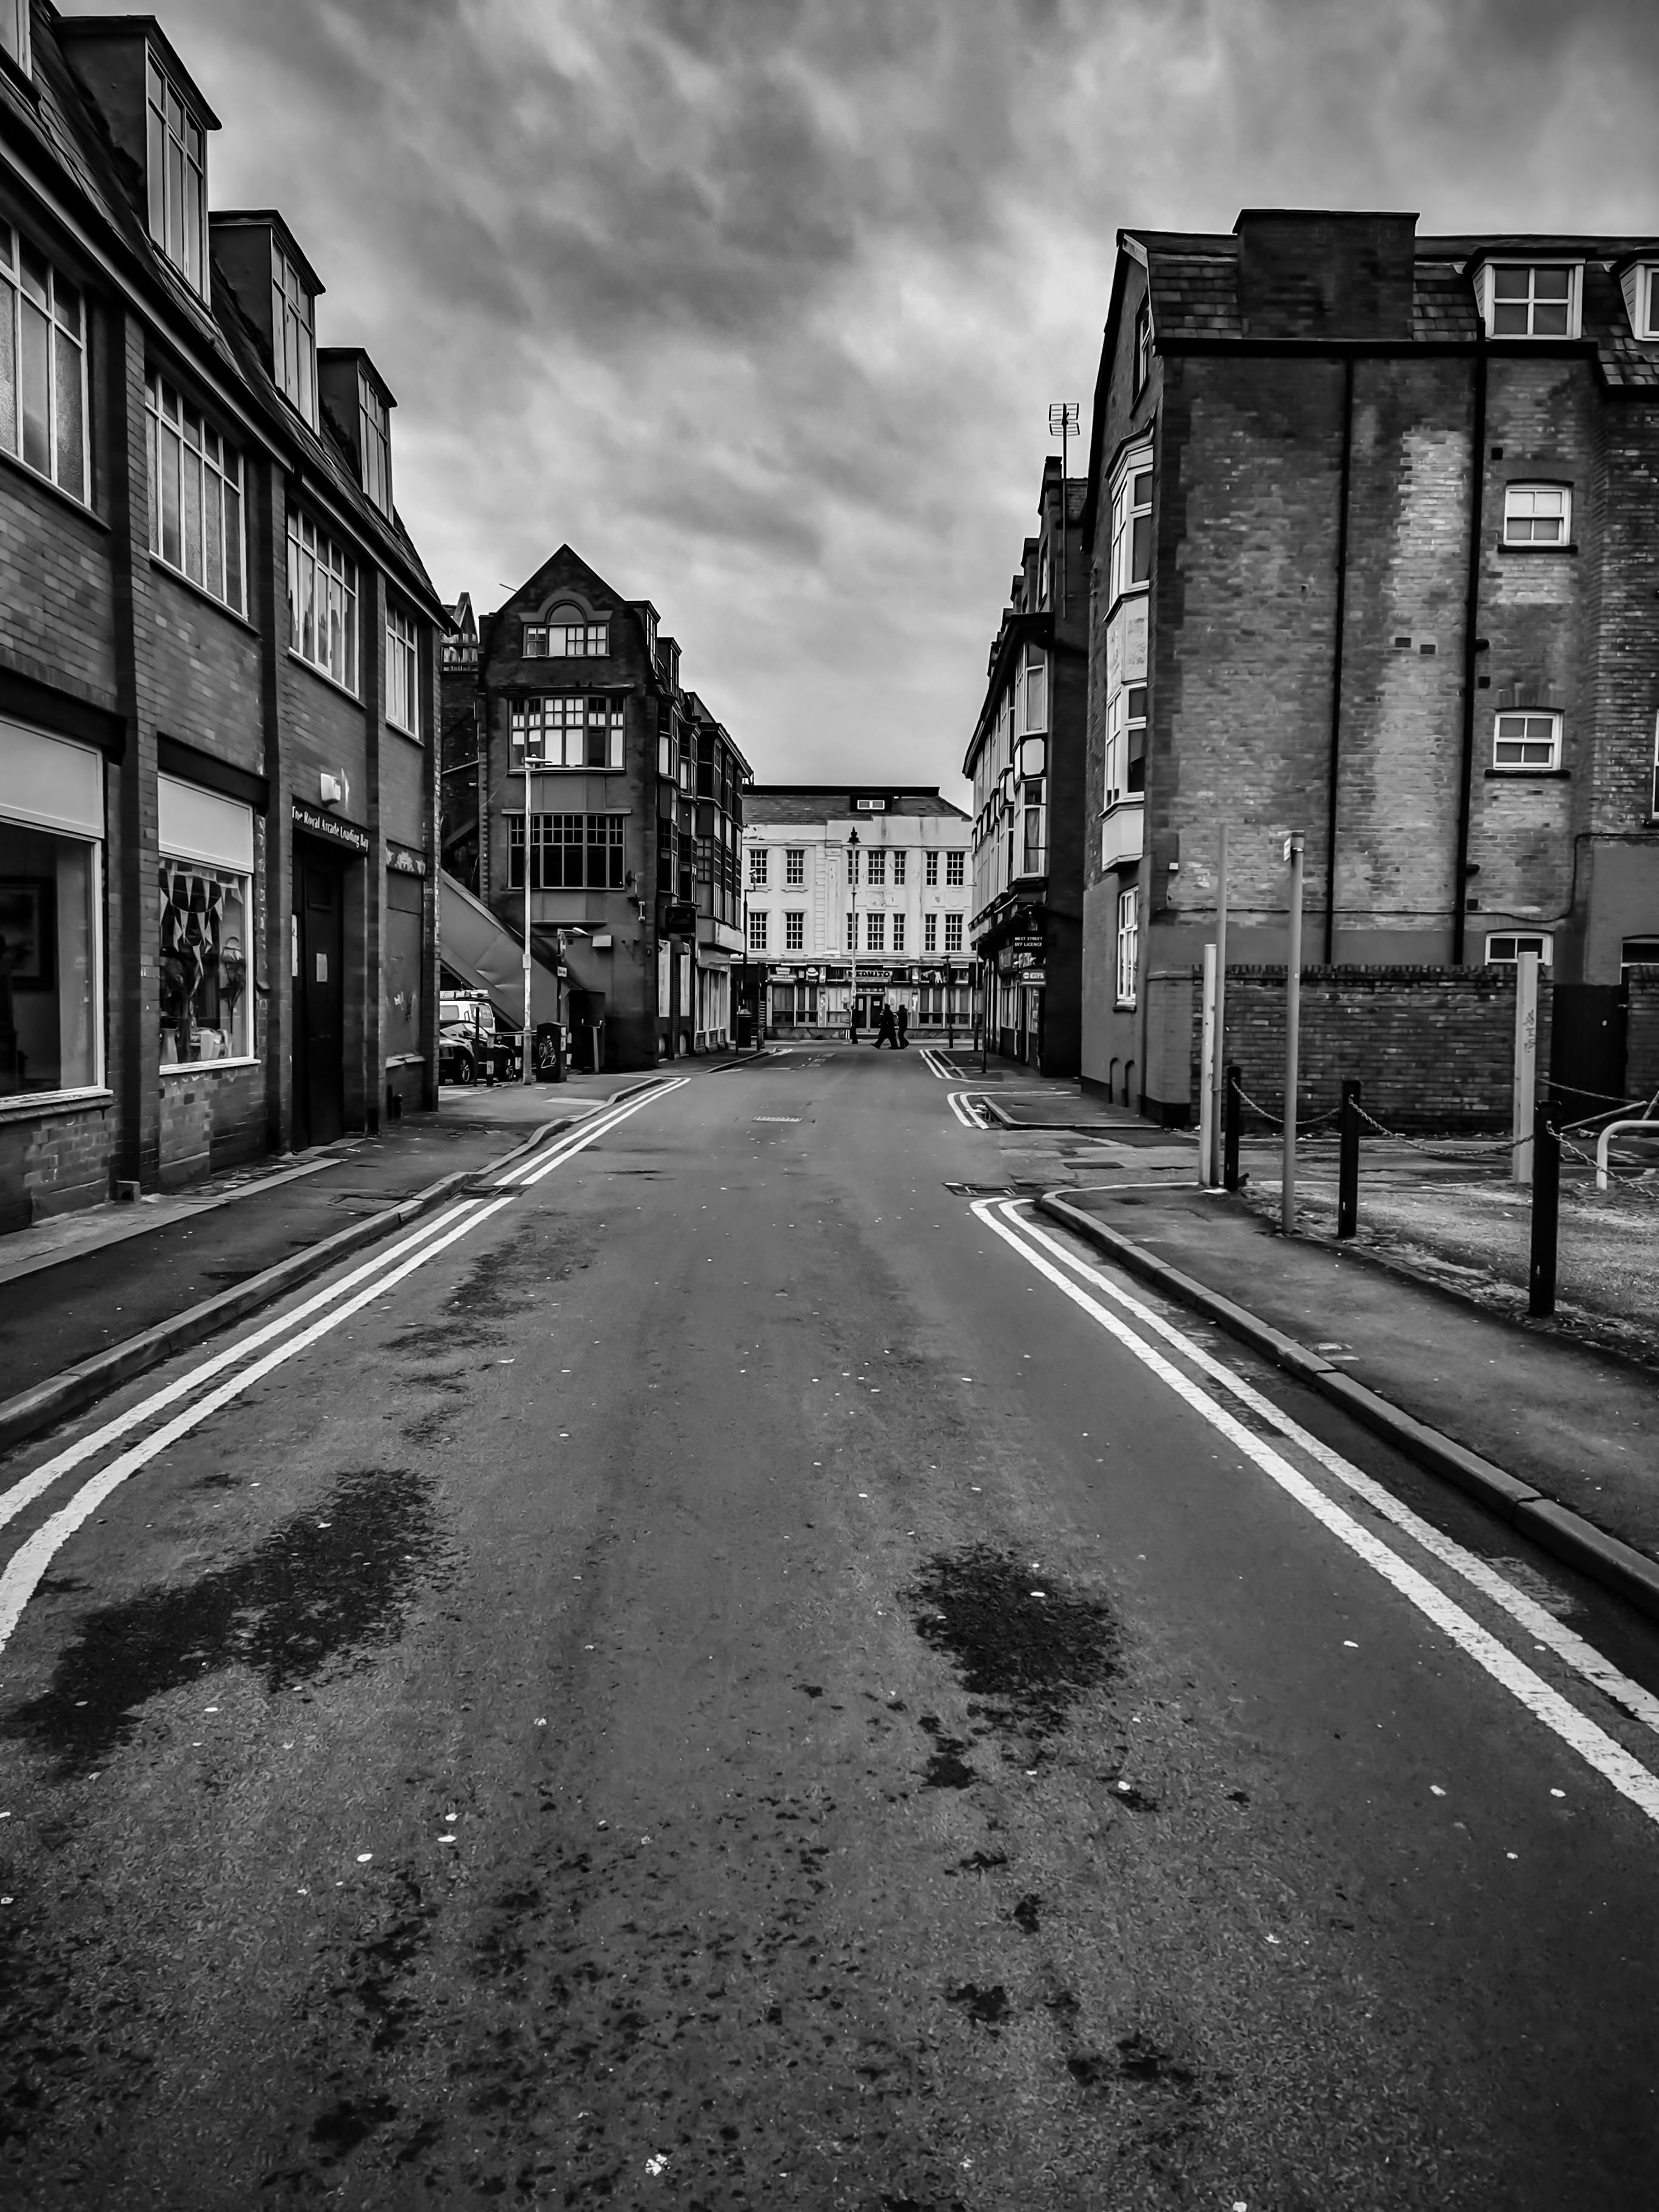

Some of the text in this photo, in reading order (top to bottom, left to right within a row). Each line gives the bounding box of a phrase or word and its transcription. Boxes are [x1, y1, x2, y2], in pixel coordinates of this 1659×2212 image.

[292, 806, 369, 852] The Royal Arcade Loading Bay
